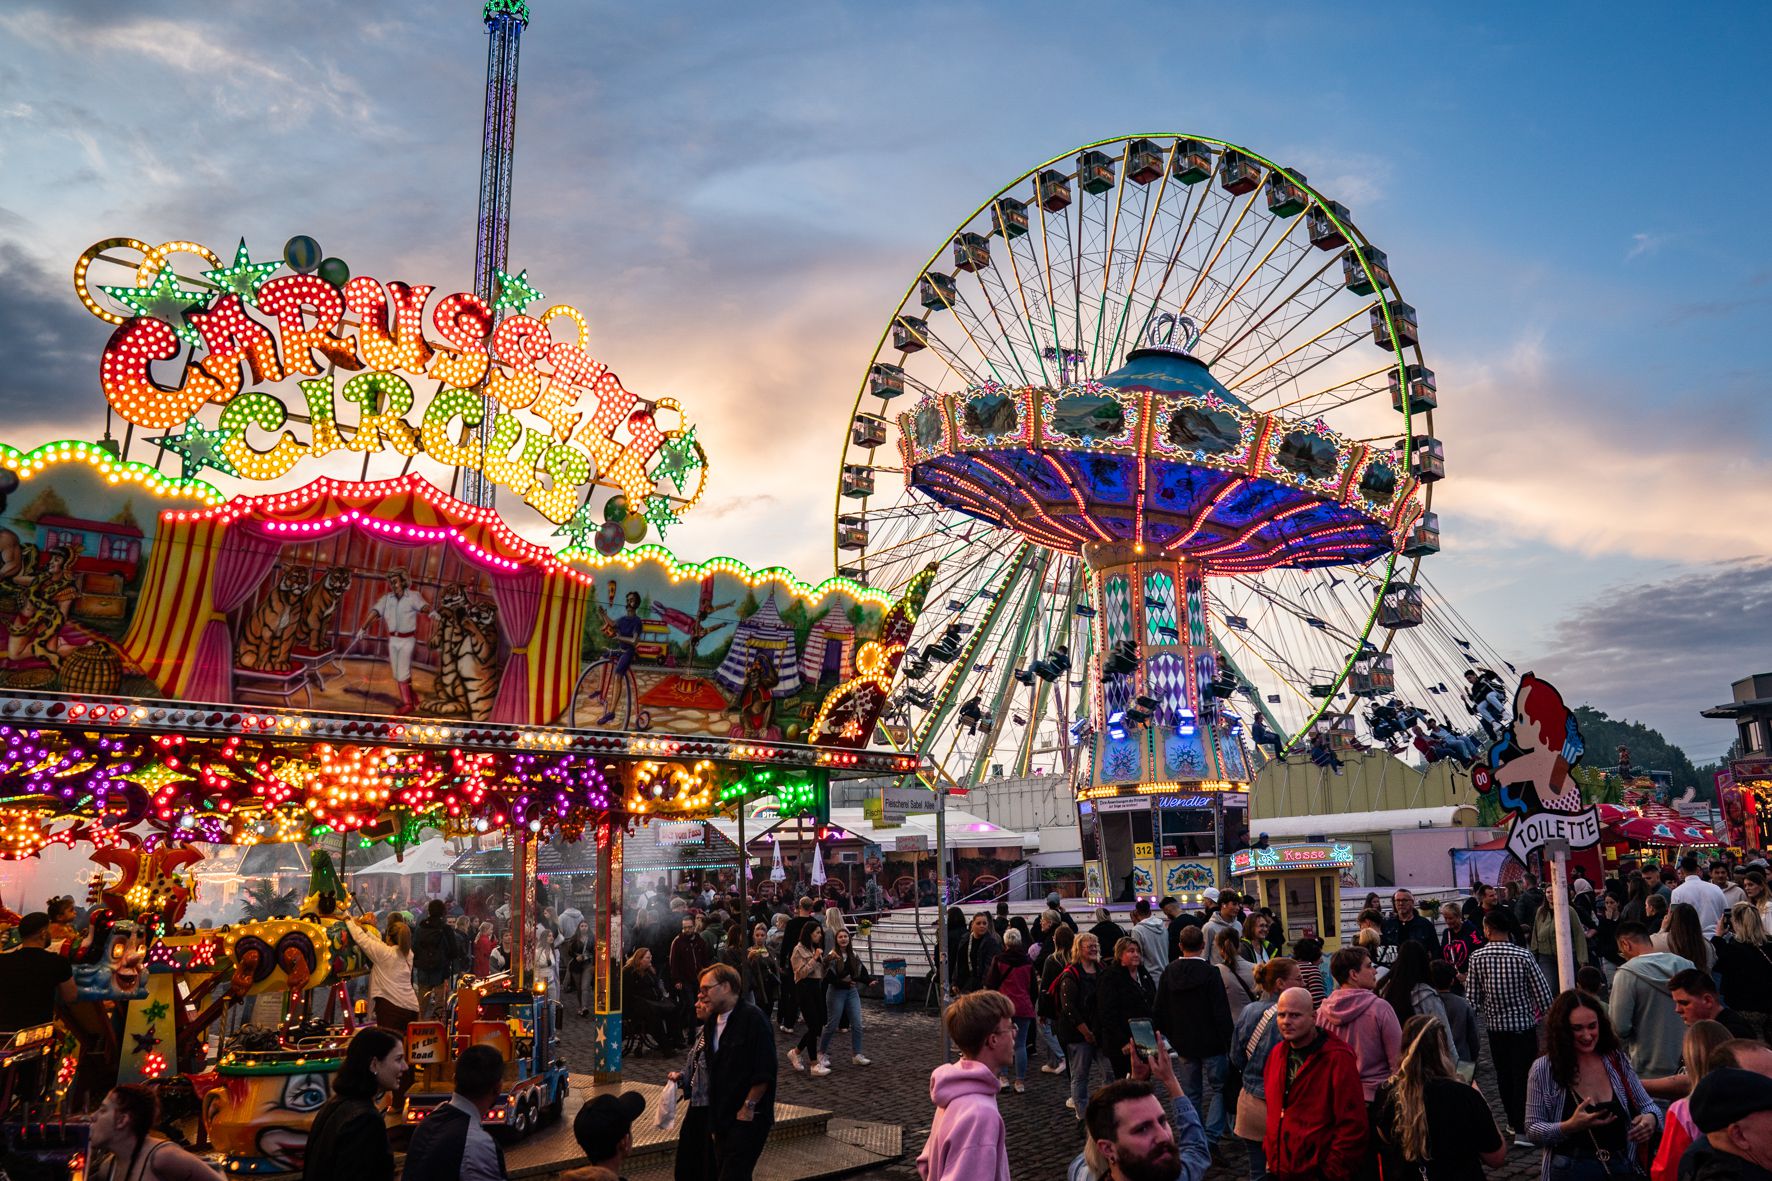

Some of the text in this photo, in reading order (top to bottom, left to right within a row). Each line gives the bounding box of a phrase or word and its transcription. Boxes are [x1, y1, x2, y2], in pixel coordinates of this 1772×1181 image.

[100, 274, 666, 515] CARUSSELL
[220, 371, 591, 525] CIRCUS
[1476, 772, 1488, 786] 00
[910, 799, 922, 810] Sabel
[1159, 795, 1215, 808] Wendler
[1515, 816, 1597, 849] TOILETTE
[1136, 846, 1152, 856] 312
[1283, 849, 1326, 862] Kasse
